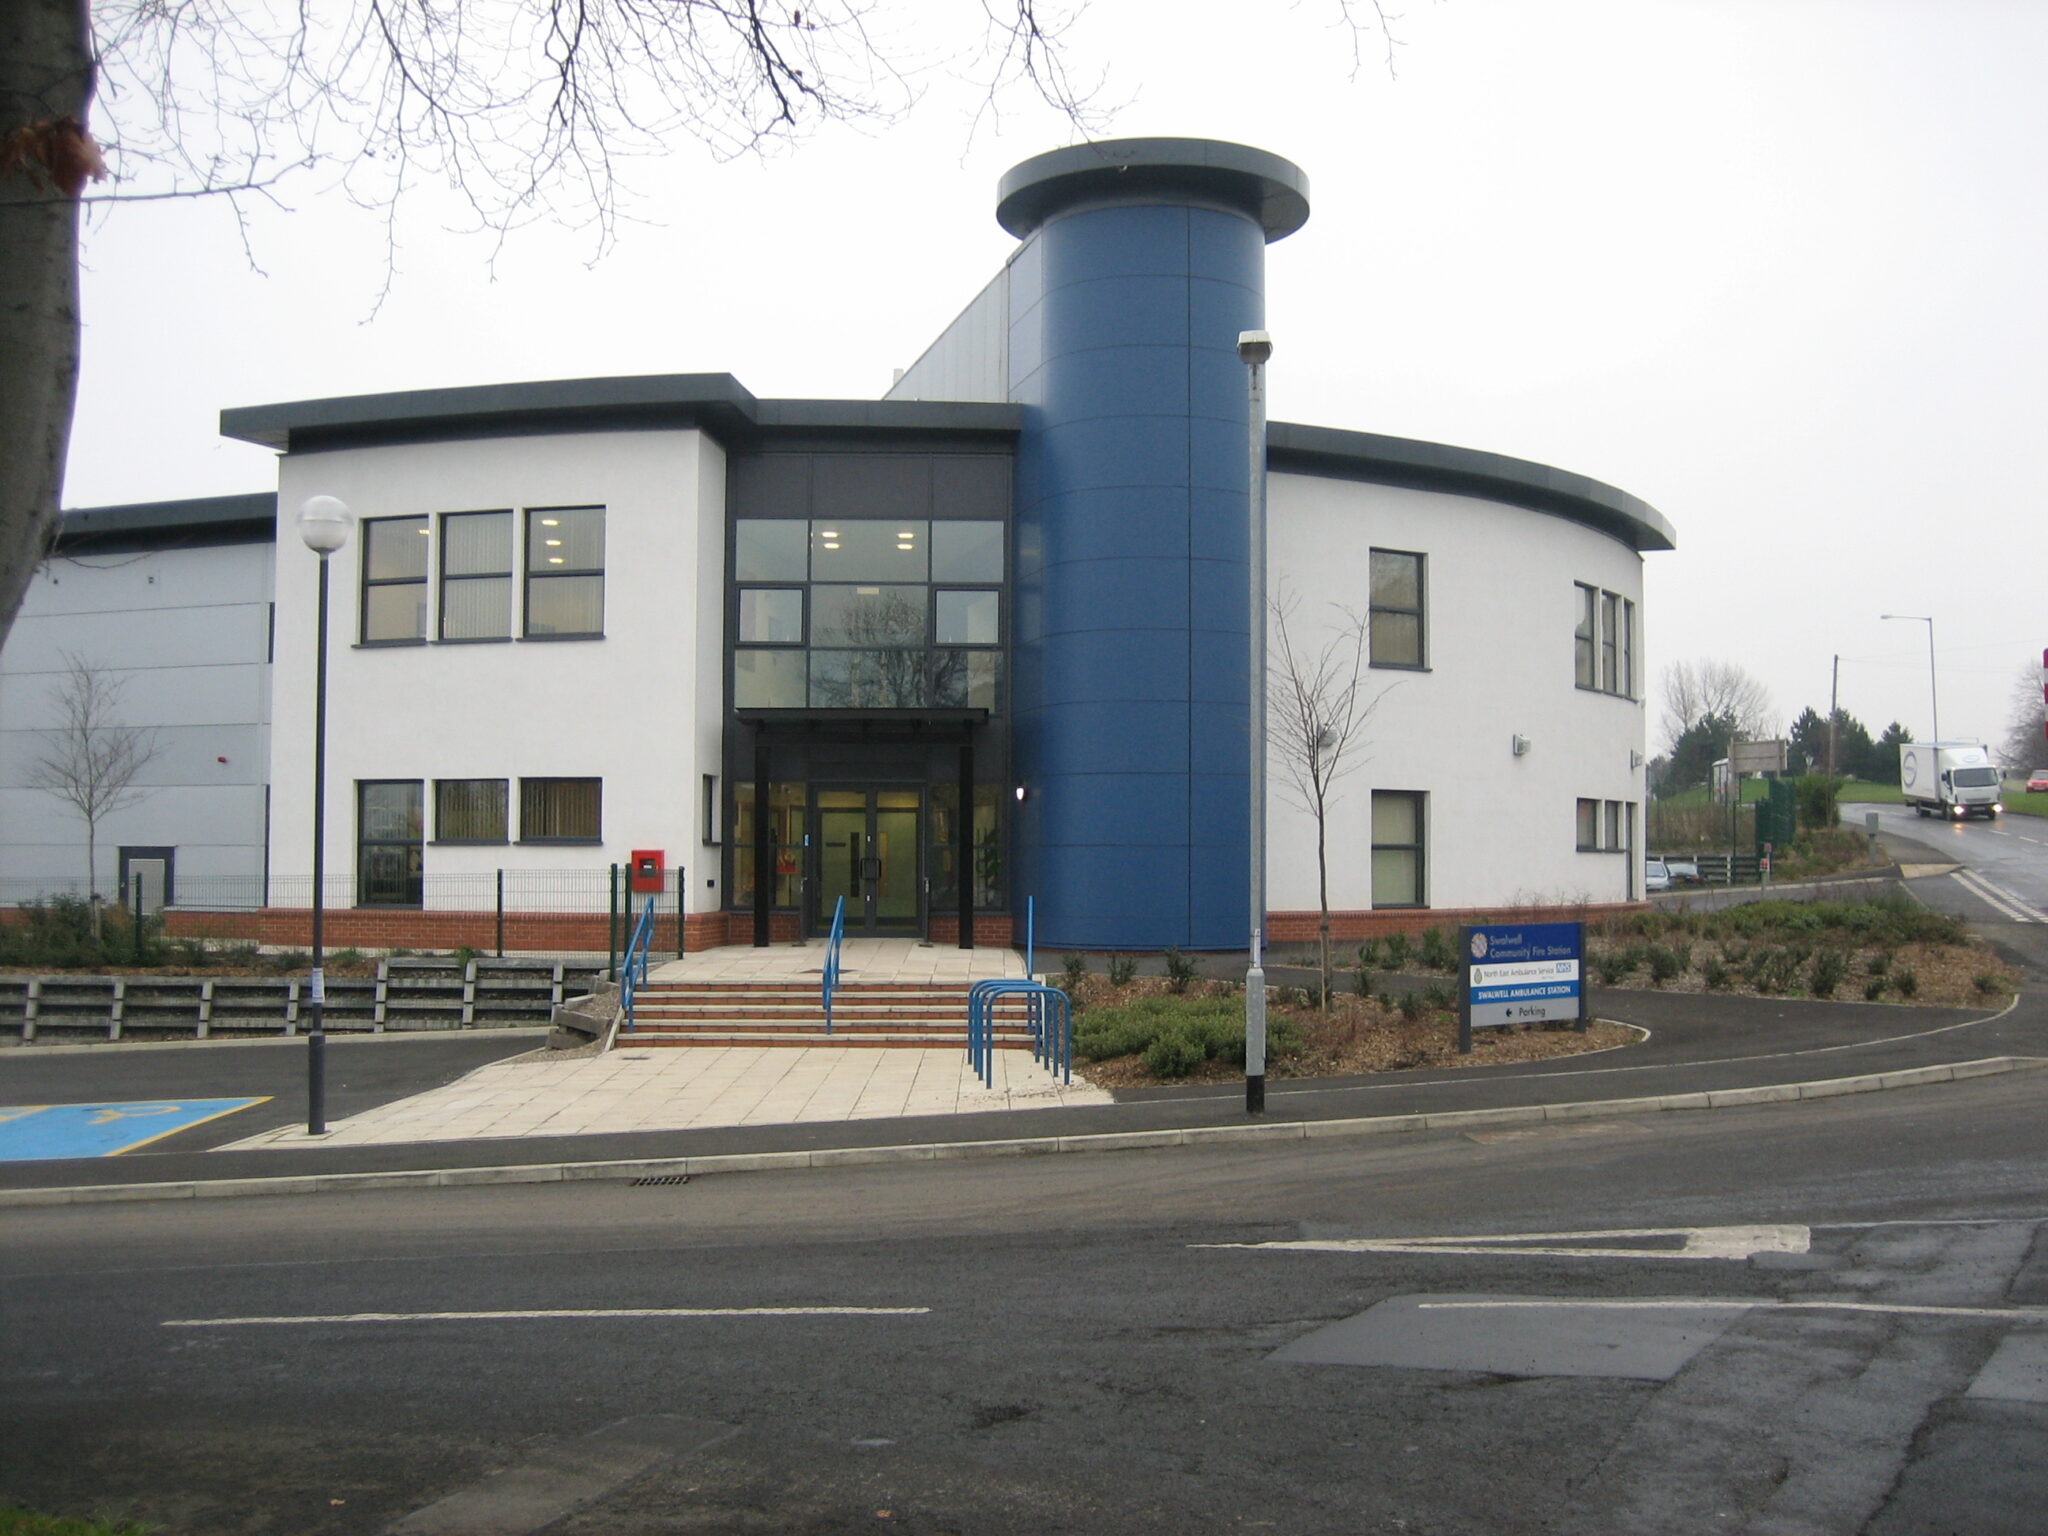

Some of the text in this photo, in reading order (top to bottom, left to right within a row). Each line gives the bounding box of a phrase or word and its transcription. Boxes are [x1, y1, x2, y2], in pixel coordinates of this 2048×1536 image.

[1490, 934, 1522, 945] Swalwell
[1490, 945, 1571, 959] Community Fire Station
[1511, 968, 1536, 976] Ambulance
[1538, 967, 1554, 975] Service
[1556, 963, 1571, 973] NHS
[1478, 985, 1571, 1000] SWALWELL AMBULANCE STATION
[1519, 1006, 1545, 1017] Parking
